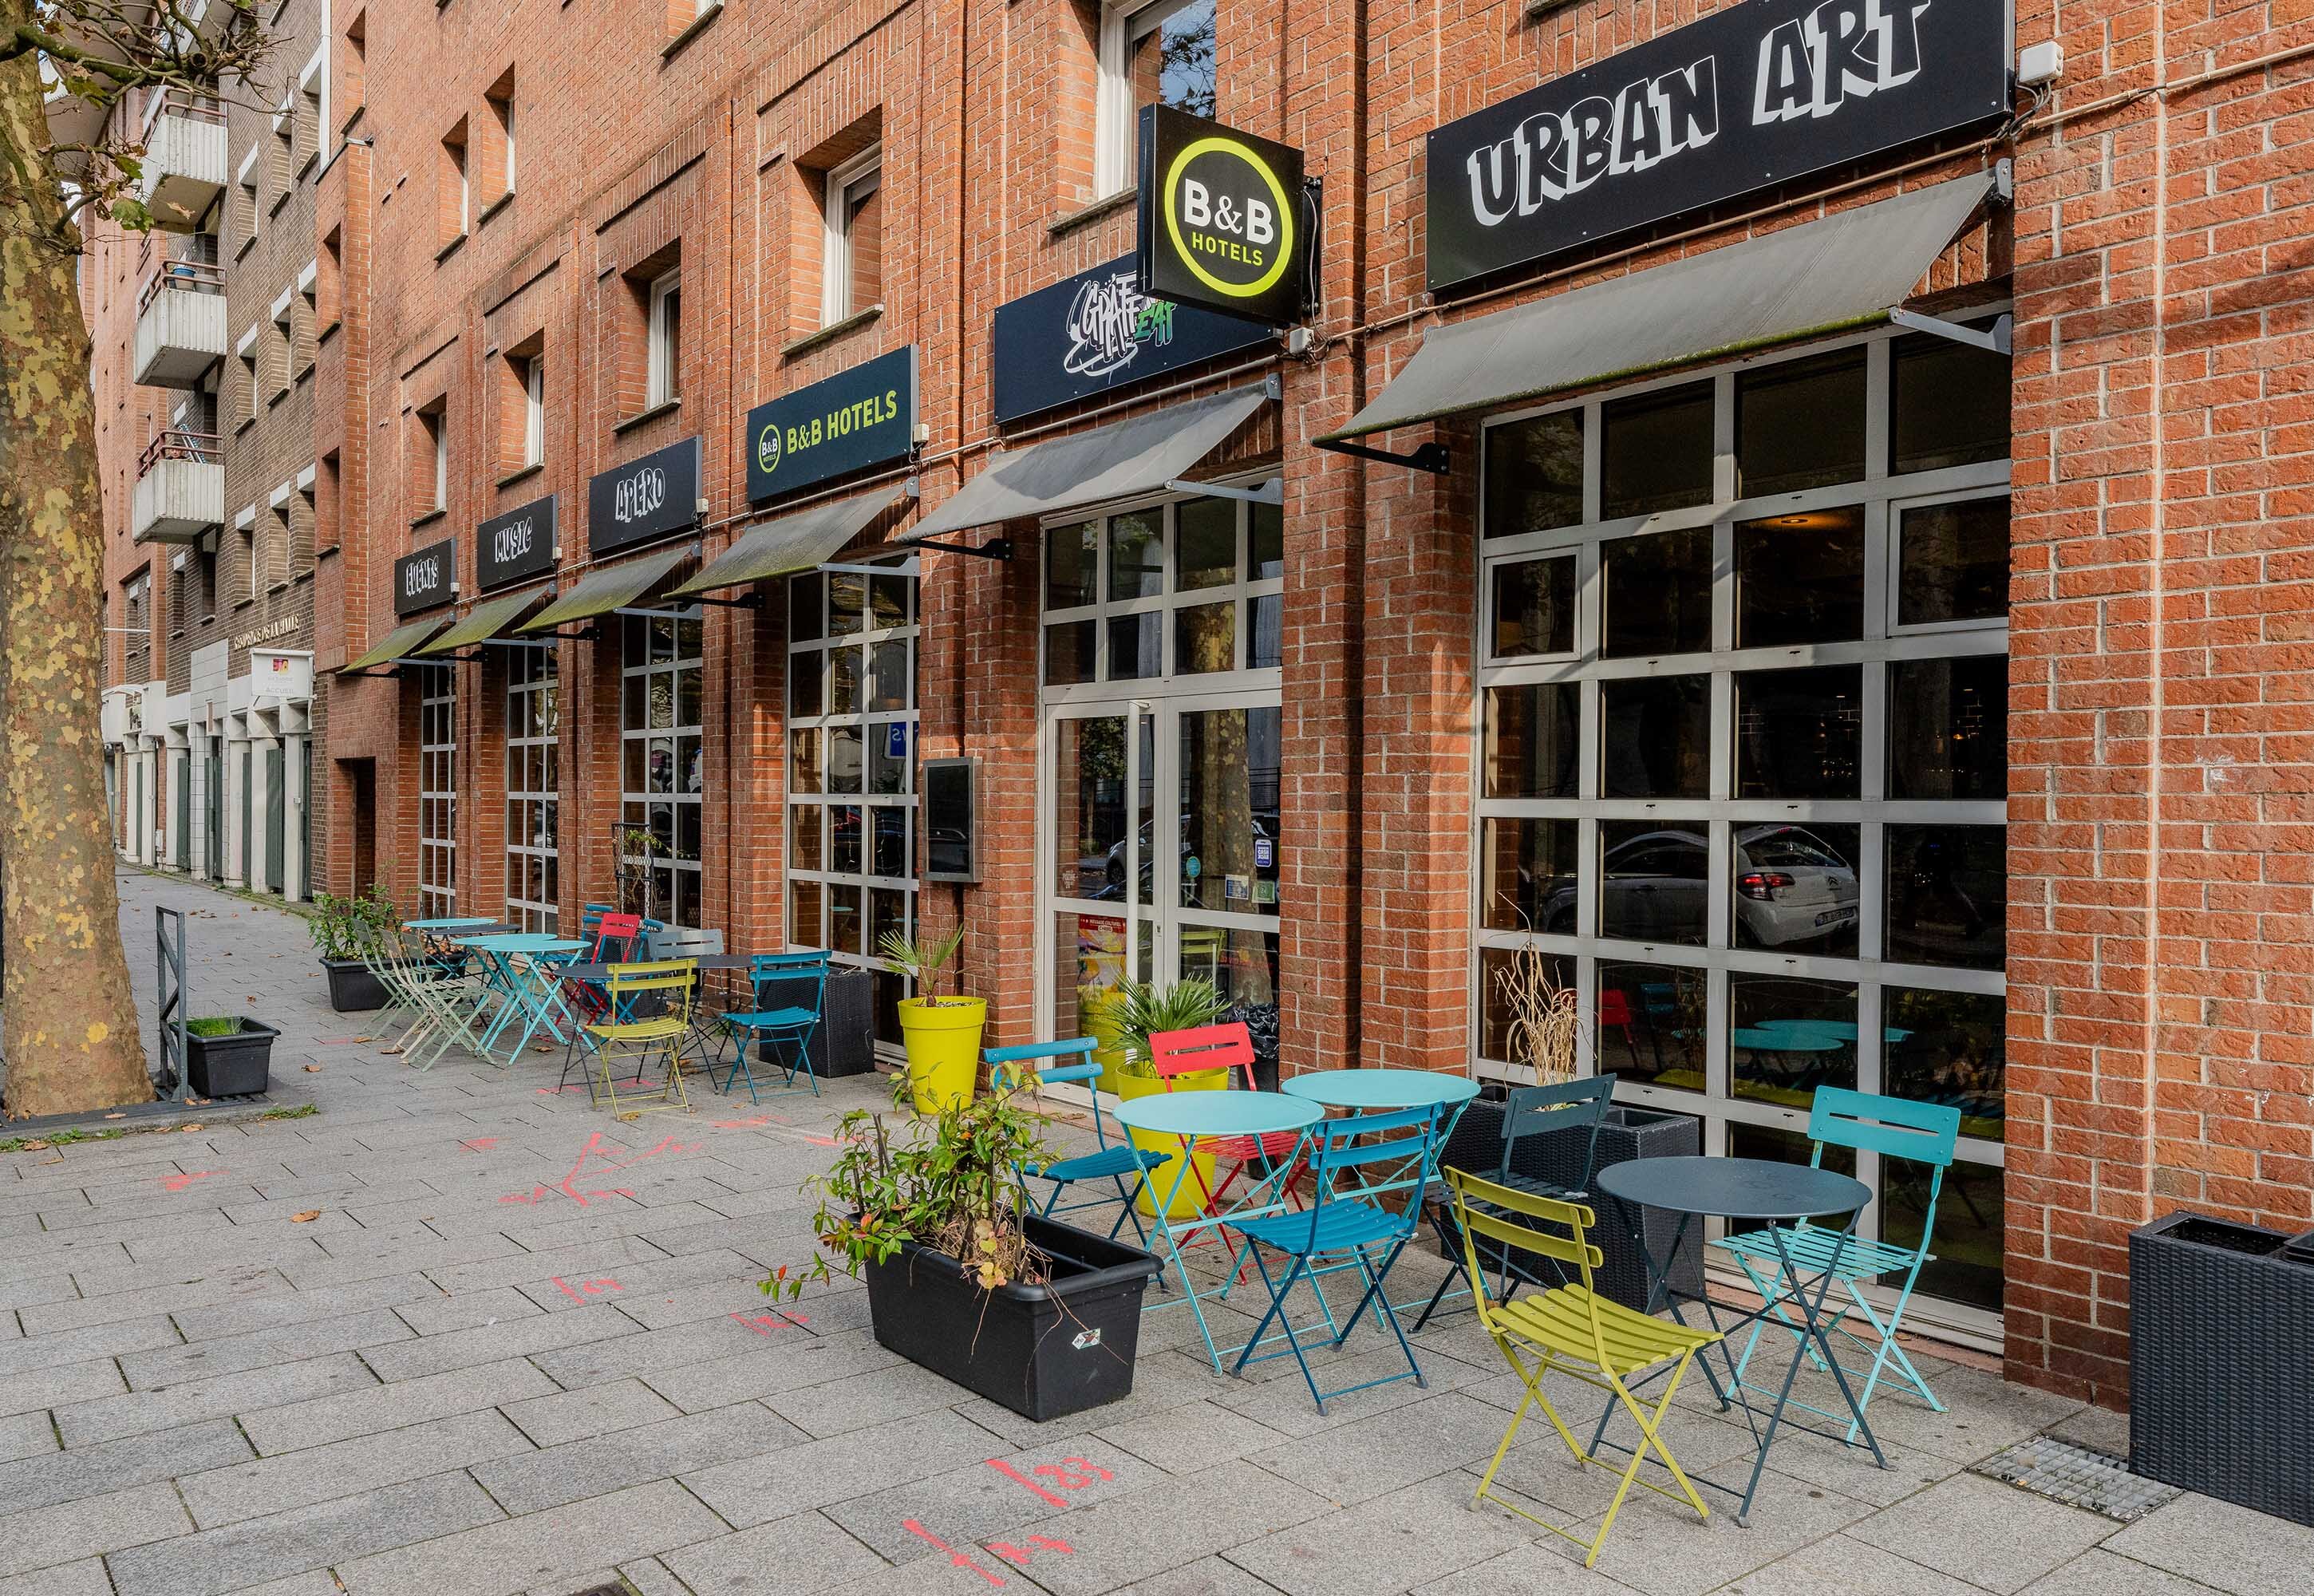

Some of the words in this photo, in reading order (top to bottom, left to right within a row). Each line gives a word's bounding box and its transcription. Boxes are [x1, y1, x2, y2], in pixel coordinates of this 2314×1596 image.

[1467, 53, 1720, 227] URBAN
[1751, 0, 1929, 126] ART
[1183, 178, 1274, 245] B&B
[1191, 231, 1264, 267] HOTELS
[1133, 299, 1179, 346] EAT
[787, 418, 823, 454] B&B
[827, 389, 898, 440] HOTELS
[761, 437, 778, 456] B&B
[763, 453, 776, 463] HOTELS
[615, 468, 665, 523] APERO
[495, 516, 533, 563] MUSIC
[405, 555, 439, 597] EVENTS
